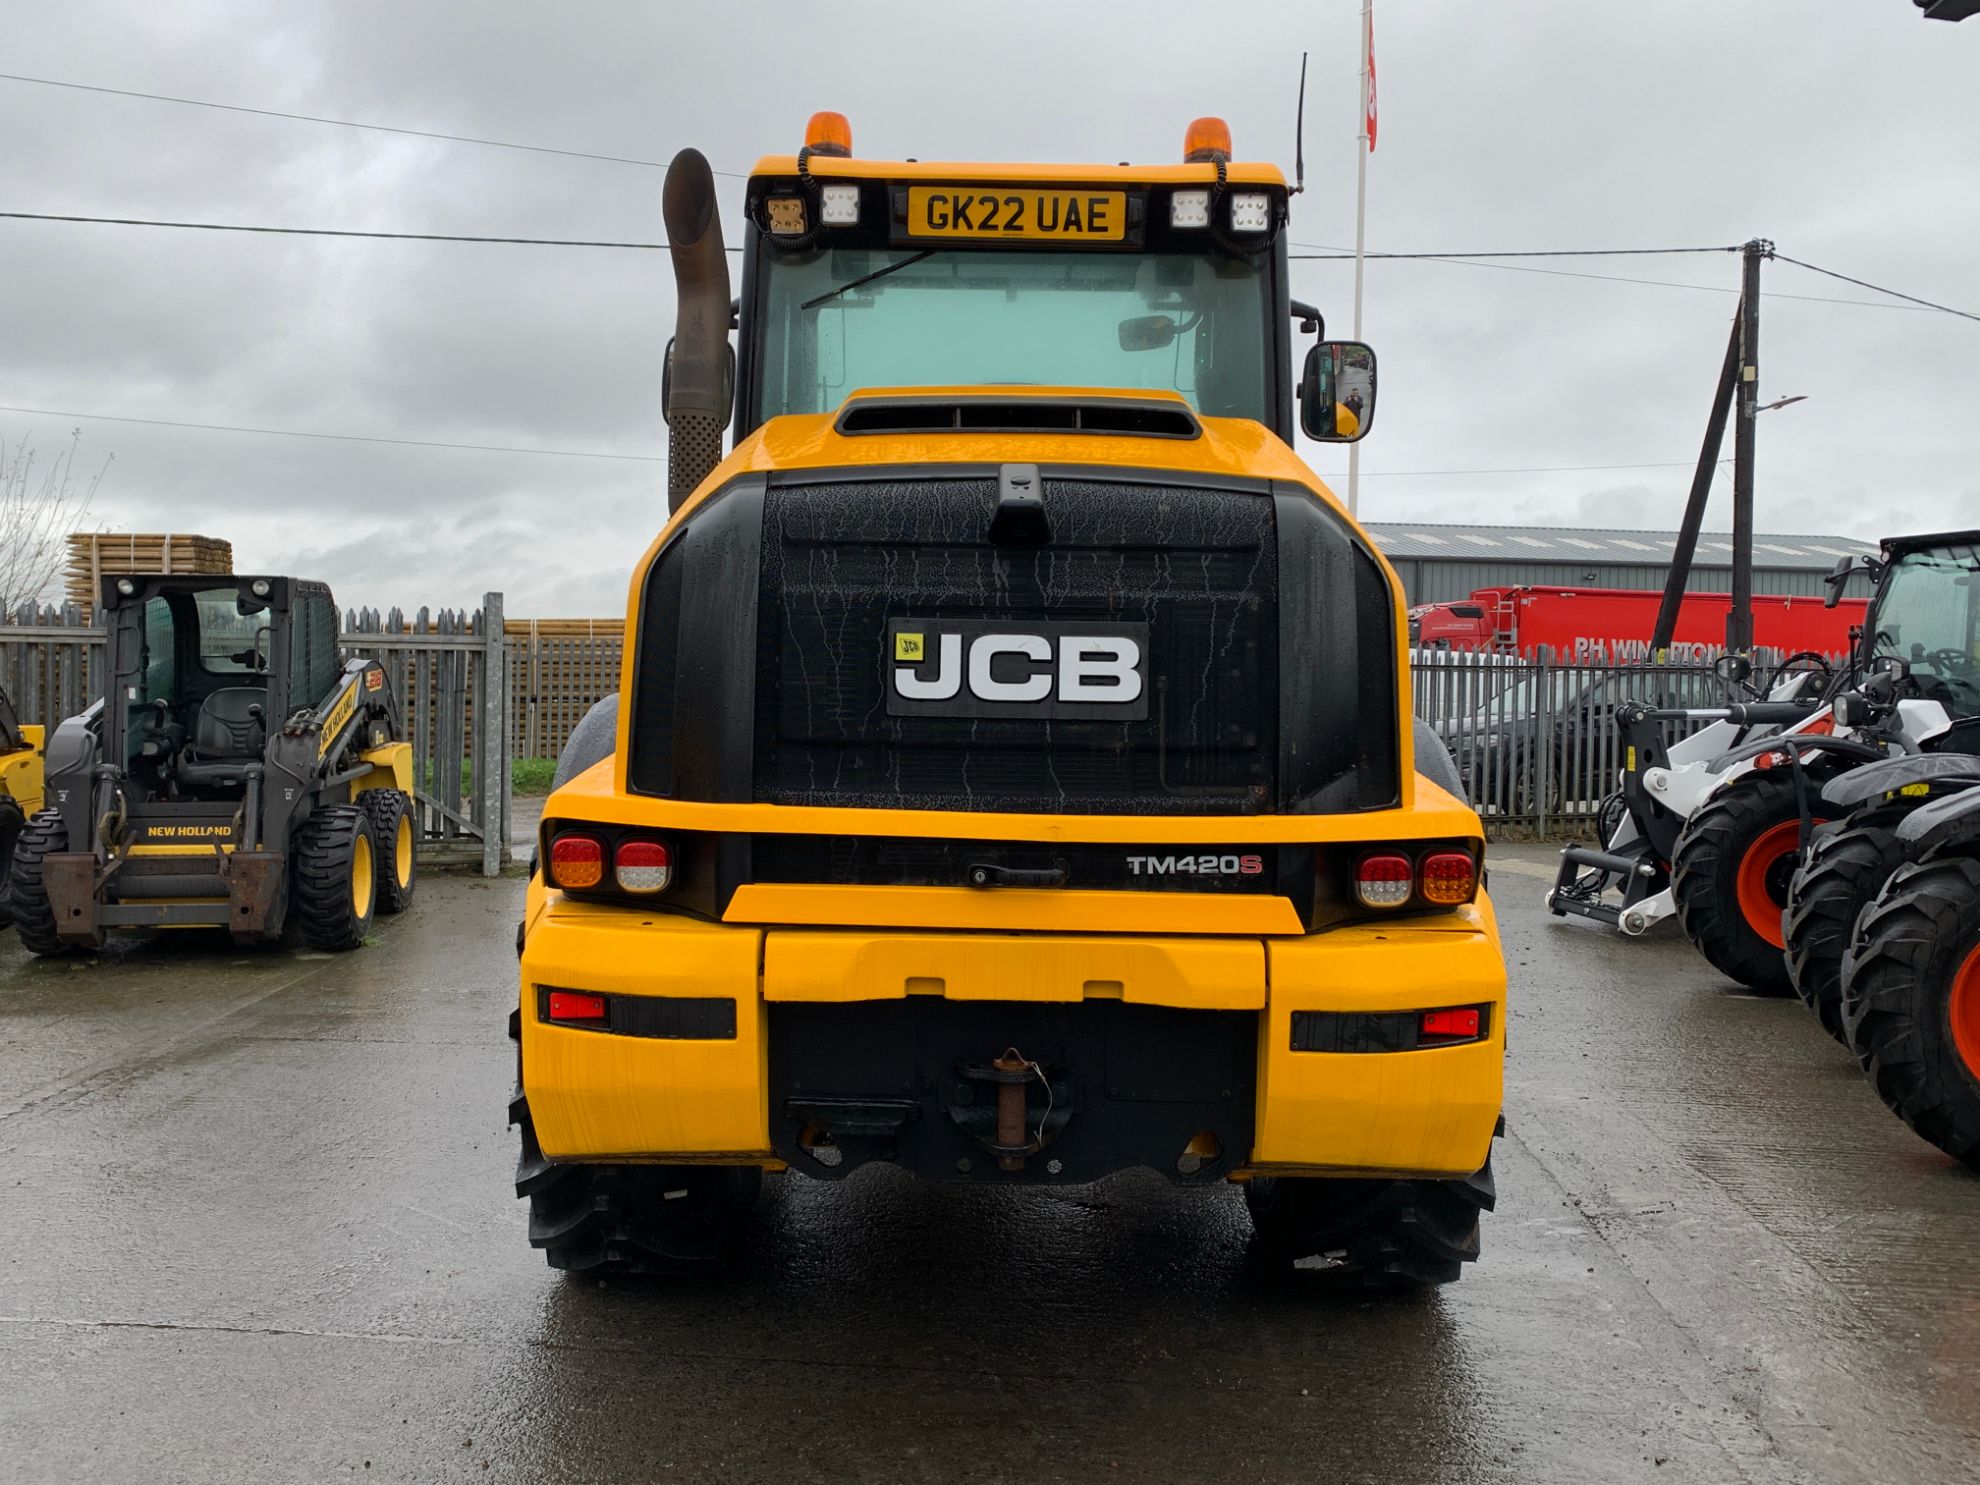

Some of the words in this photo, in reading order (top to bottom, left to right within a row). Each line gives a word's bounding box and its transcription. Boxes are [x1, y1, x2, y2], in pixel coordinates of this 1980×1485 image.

[927, 194, 1025, 232] GK22
[1036, 197, 1110, 233] UAE
[894, 632, 1143, 702] JCB
[148, 826, 175, 837] NEW
[177, 826, 232, 836] HOLLAND
[1126, 855, 1263, 875] TM420S
